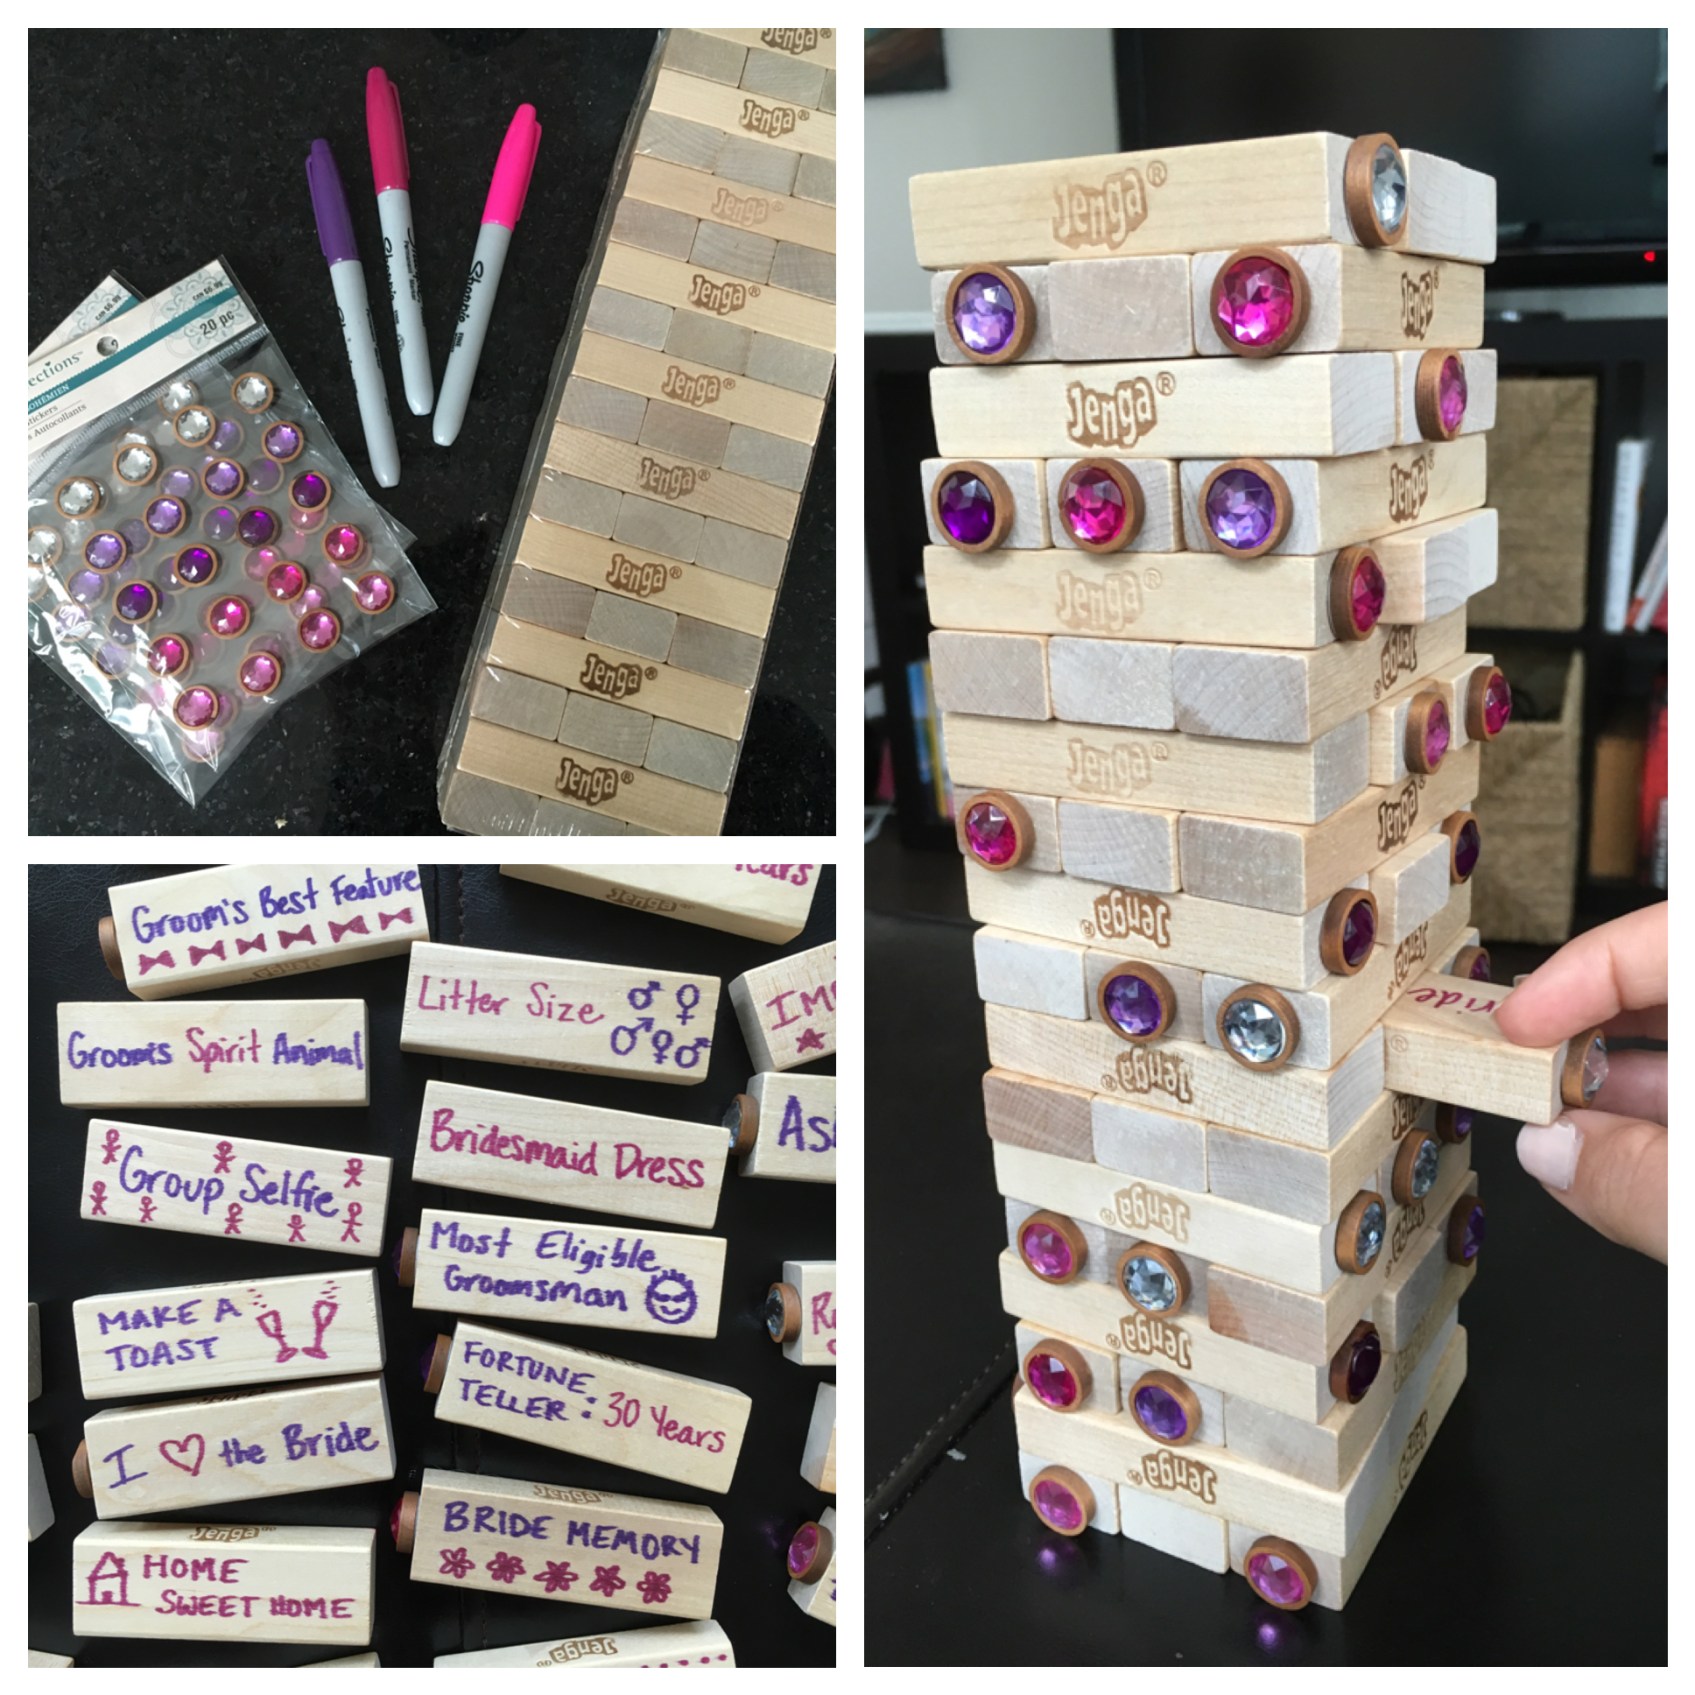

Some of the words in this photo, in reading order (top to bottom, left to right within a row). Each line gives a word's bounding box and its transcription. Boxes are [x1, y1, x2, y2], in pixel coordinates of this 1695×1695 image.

[740, 99, 796, 137] Jenga
[711, 188, 769, 226] Jenga
[1052, 167, 1148, 250] Jenga
[688, 275, 746, 315] Jenga
[1400, 269, 1434, 341] Jenga
[200, 319, 217, 336] 20
[219, 310, 235, 327] pc
[661, 365, 721, 406] Jenga
[1067, 376, 1158, 449] Jenga
[34, 404, 87, 437] Autocollants
[640, 457, 696, 499] Jenga
[1388, 455, 1430, 524] Jenga
[606, 553, 667, 597] Jenga
[1056, 568, 1144, 631] Jenga
[580, 653, 642, 699] Jenga
[556, 757, 617, 805] Jenga
[1067, 738, 1151, 797] Jenga
[1378, 780, 1419, 852] Jenga
[132, 898, 249, 944] Groom's
[258, 877, 319, 918] Best
[330, 867, 421, 906] Feature
[1093, 887, 1170, 950] Jenga
[418, 975, 509, 1017] Litter
[526, 982, 605, 1024] Size
[1407, 986, 1495, 1015] ride
[185, 1027, 261, 1073] Spirit
[273, 1031, 364, 1070] Animal
[1116, 1045, 1195, 1105] Jenga
[429, 1108, 599, 1177] Bridesmaid
[614, 1143, 705, 1188] Dress
[777, 1095, 836, 1153] As
[119, 1145, 224, 1215] Group
[239, 1162, 339, 1218] Selfie
[1114, 1182, 1190, 1243] Jenga
[430, 1221, 511, 1259] Most
[535, 1230, 661, 1275] Eligible
[443, 1264, 629, 1313] Groomsman
[97, 1299, 202, 1335] MAKE
[213, 1298, 242, 1323] A
[1120, 1313, 1193, 1370] Jenga
[104, 1336, 219, 1371] TOAST
[463, 1340, 597, 1394] FORTUNE
[602, 1391, 641, 1429] 30
[651, 1407, 725, 1454] Years
[103, 1444, 148, 1489] I
[219, 1438, 267, 1468] the
[282, 1421, 379, 1461] Bride
[1142, 1450, 1217, 1505] Jenga
[191, 1526, 260, 1543] Jenga
[444, 1501, 554, 1541] BRIDE
[566, 1519, 701, 1564] MEMORY
[143, 1554, 249, 1584] HOME
[155, 1589, 261, 1618] SWEET
[270, 1595, 355, 1619] HOME
